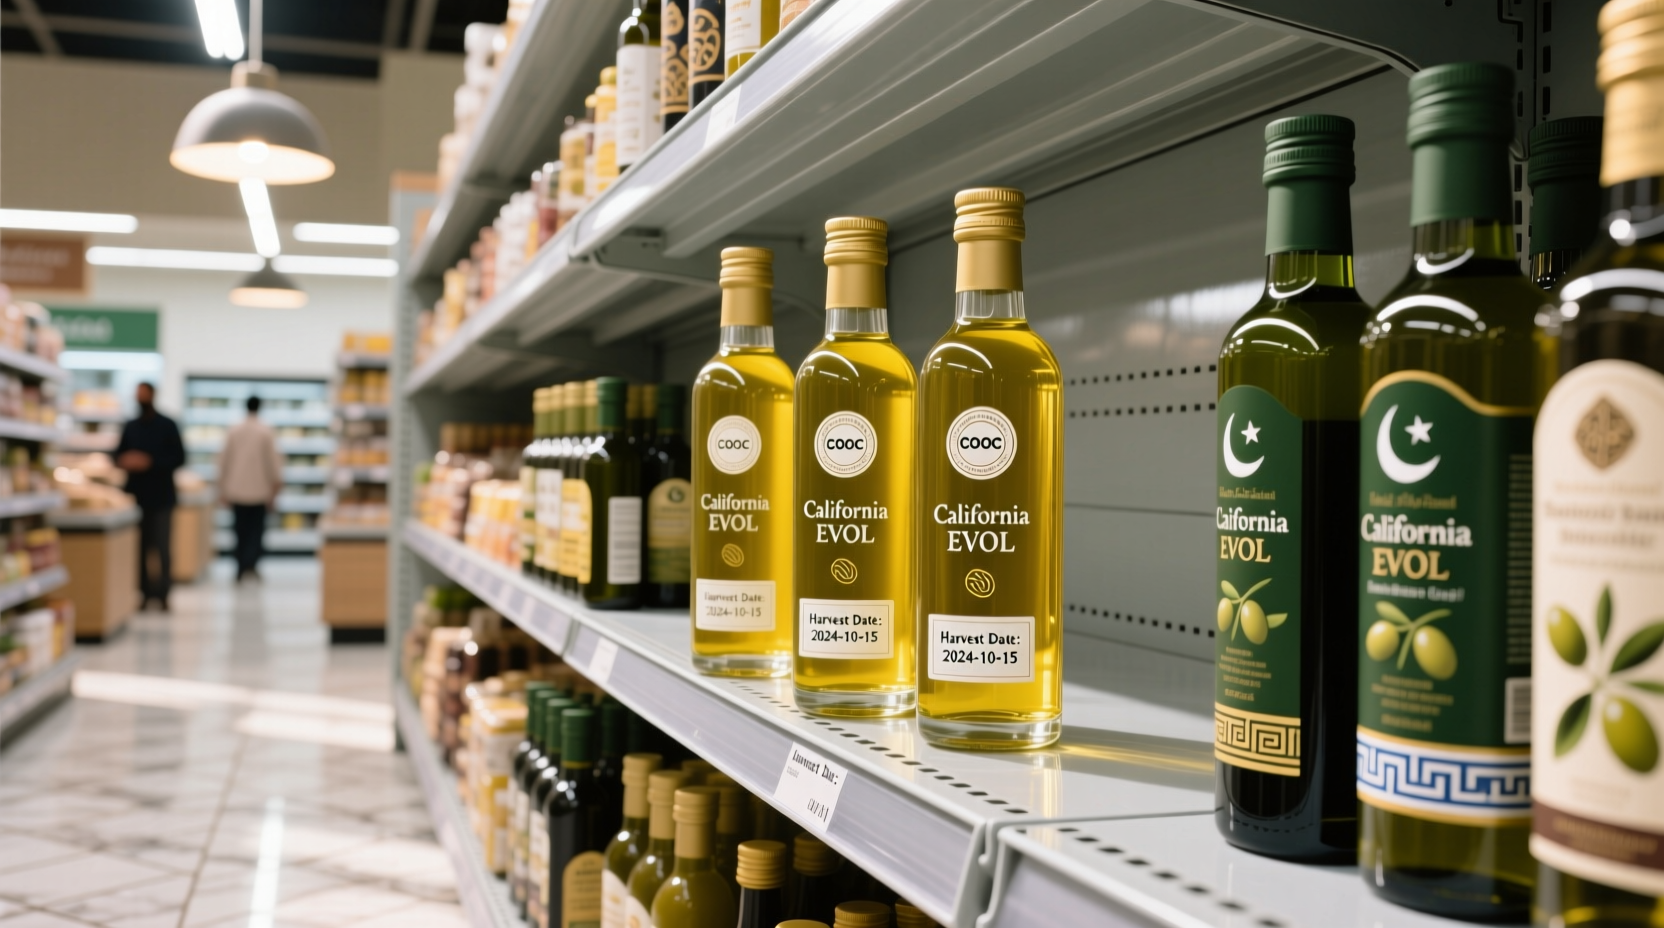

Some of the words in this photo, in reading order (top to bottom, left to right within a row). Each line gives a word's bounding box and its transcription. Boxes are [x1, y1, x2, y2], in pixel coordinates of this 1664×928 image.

[717, 439, 750, 450] COOC
[826, 438, 864, 450] COOC
[960, 436, 1002, 449] COOC
[700, 493, 770, 511] California
[803, 499, 888, 519] California
[708, 513, 759, 532] EVOL
[933, 503, 1030, 525] California
[815, 523, 875, 544] EVOL
[1361, 513, 1473, 547] California
[947, 530, 1016, 553] EVOL
[1220, 535, 1271, 563] EVOL
[1371, 547, 1450, 581] EVOL
[809, 613, 849, 626] Harvest
[853, 614, 882, 626] Date:
[811, 629, 878, 643] 2024-10-15
[940, 631, 984, 645] Harvest
[988, 632, 1021, 645] Date:
[942, 649, 1018, 665] 2024-10-15
